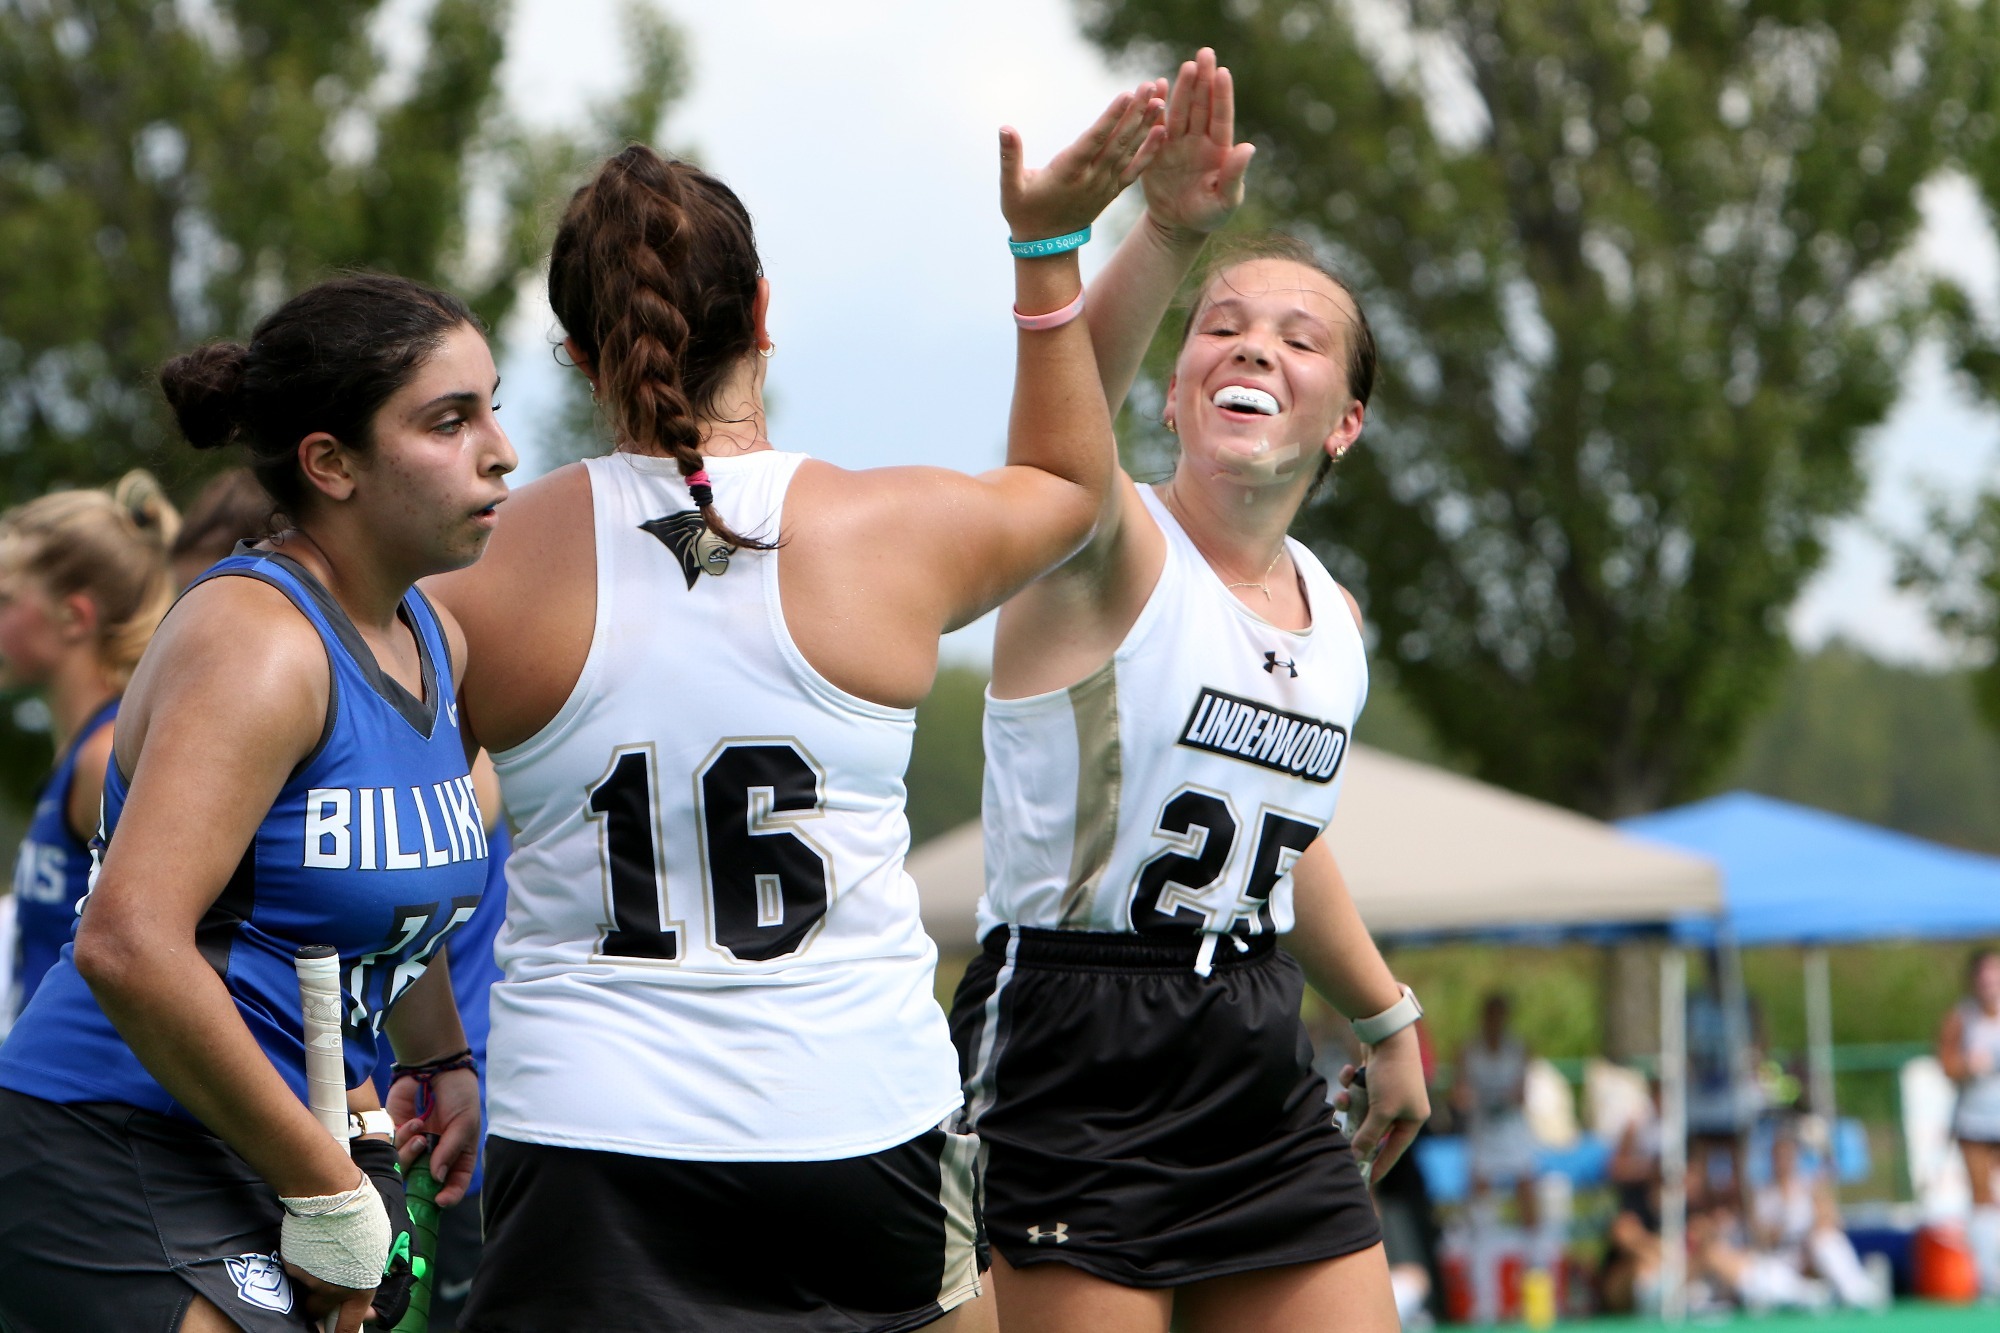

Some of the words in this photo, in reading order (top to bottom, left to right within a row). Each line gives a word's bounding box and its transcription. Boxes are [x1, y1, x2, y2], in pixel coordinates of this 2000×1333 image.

[1046, 242, 1053, 250] D
[1056, 234, 1082, 248] SQUAD
[1185, 693, 1345, 778] LINDENWOOD
[583, 735, 838, 967] 16
[1127, 783, 1327, 934] 25
